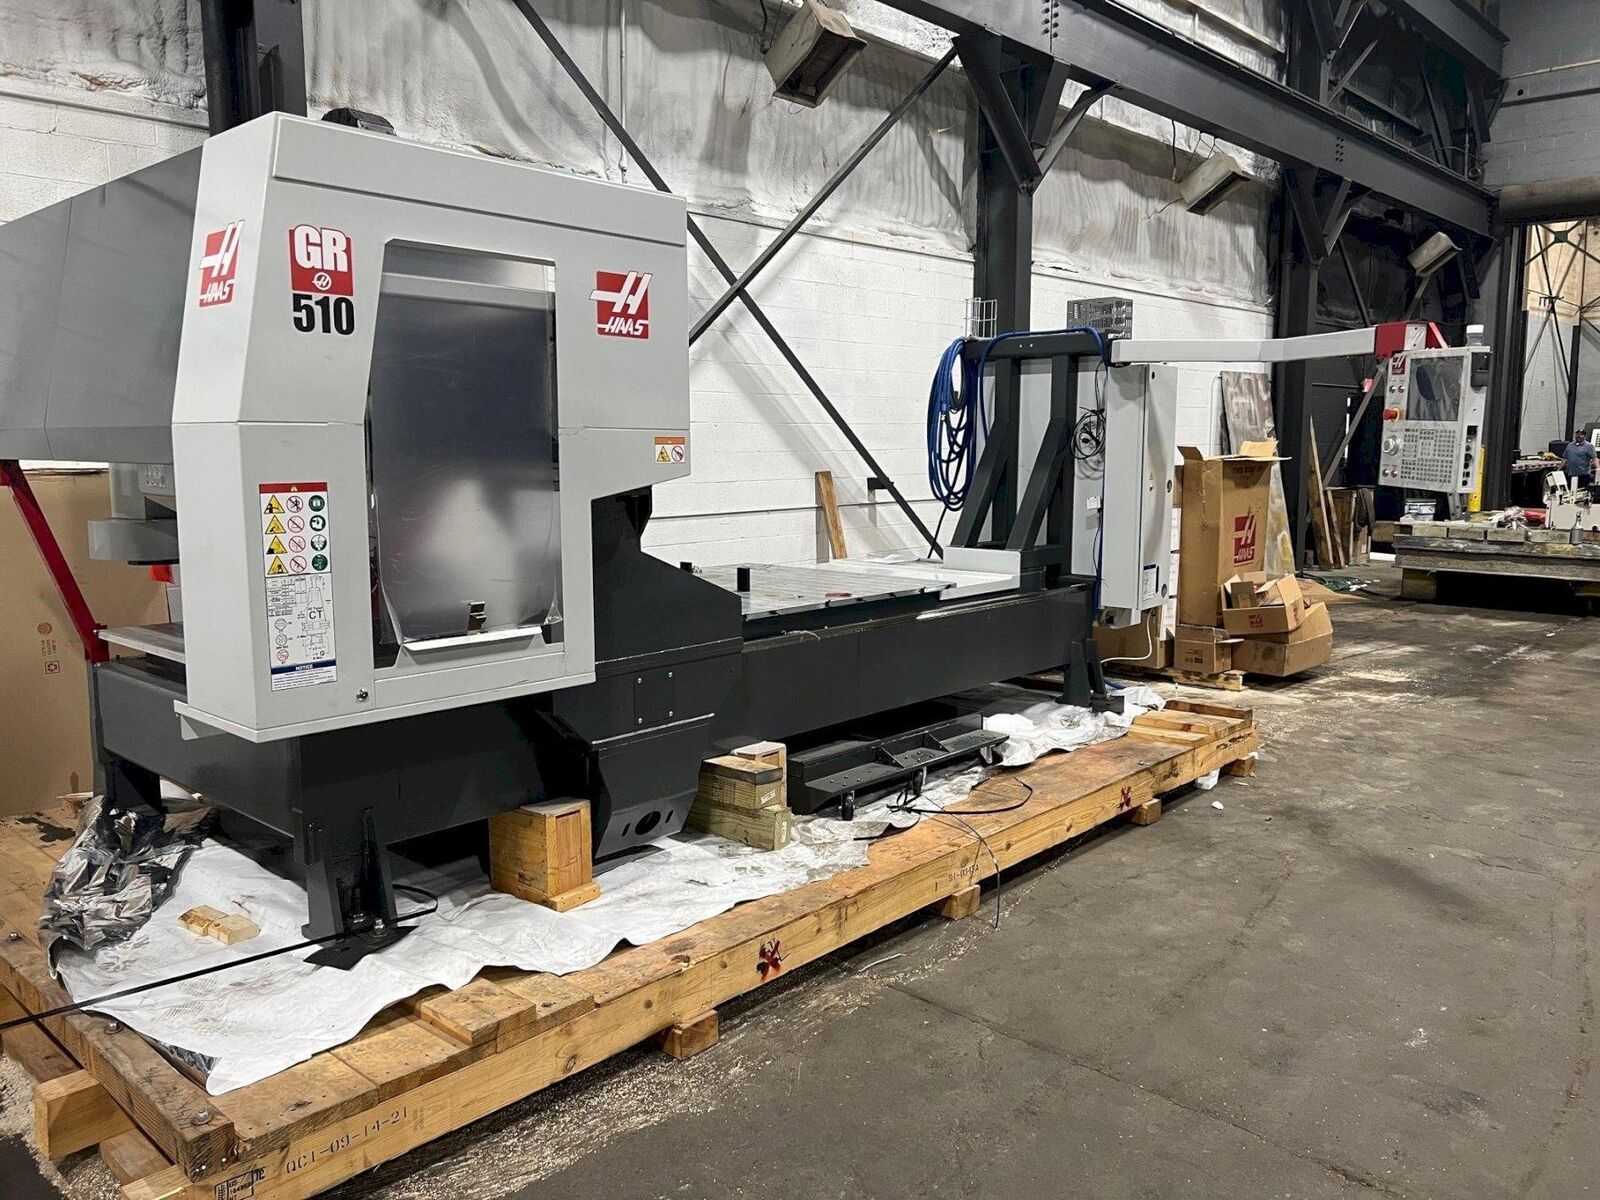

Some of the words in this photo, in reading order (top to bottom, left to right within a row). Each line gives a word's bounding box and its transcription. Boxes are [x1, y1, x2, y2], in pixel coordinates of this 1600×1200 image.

[294, 224, 349, 273] GR
[200, 279, 235, 303] HAAS
[292, 293, 355, 336] 510
[597, 316, 649, 335] HAAS
[1234, 546, 1255, 561] HAAS
[309, 610, 323, 620] CT
